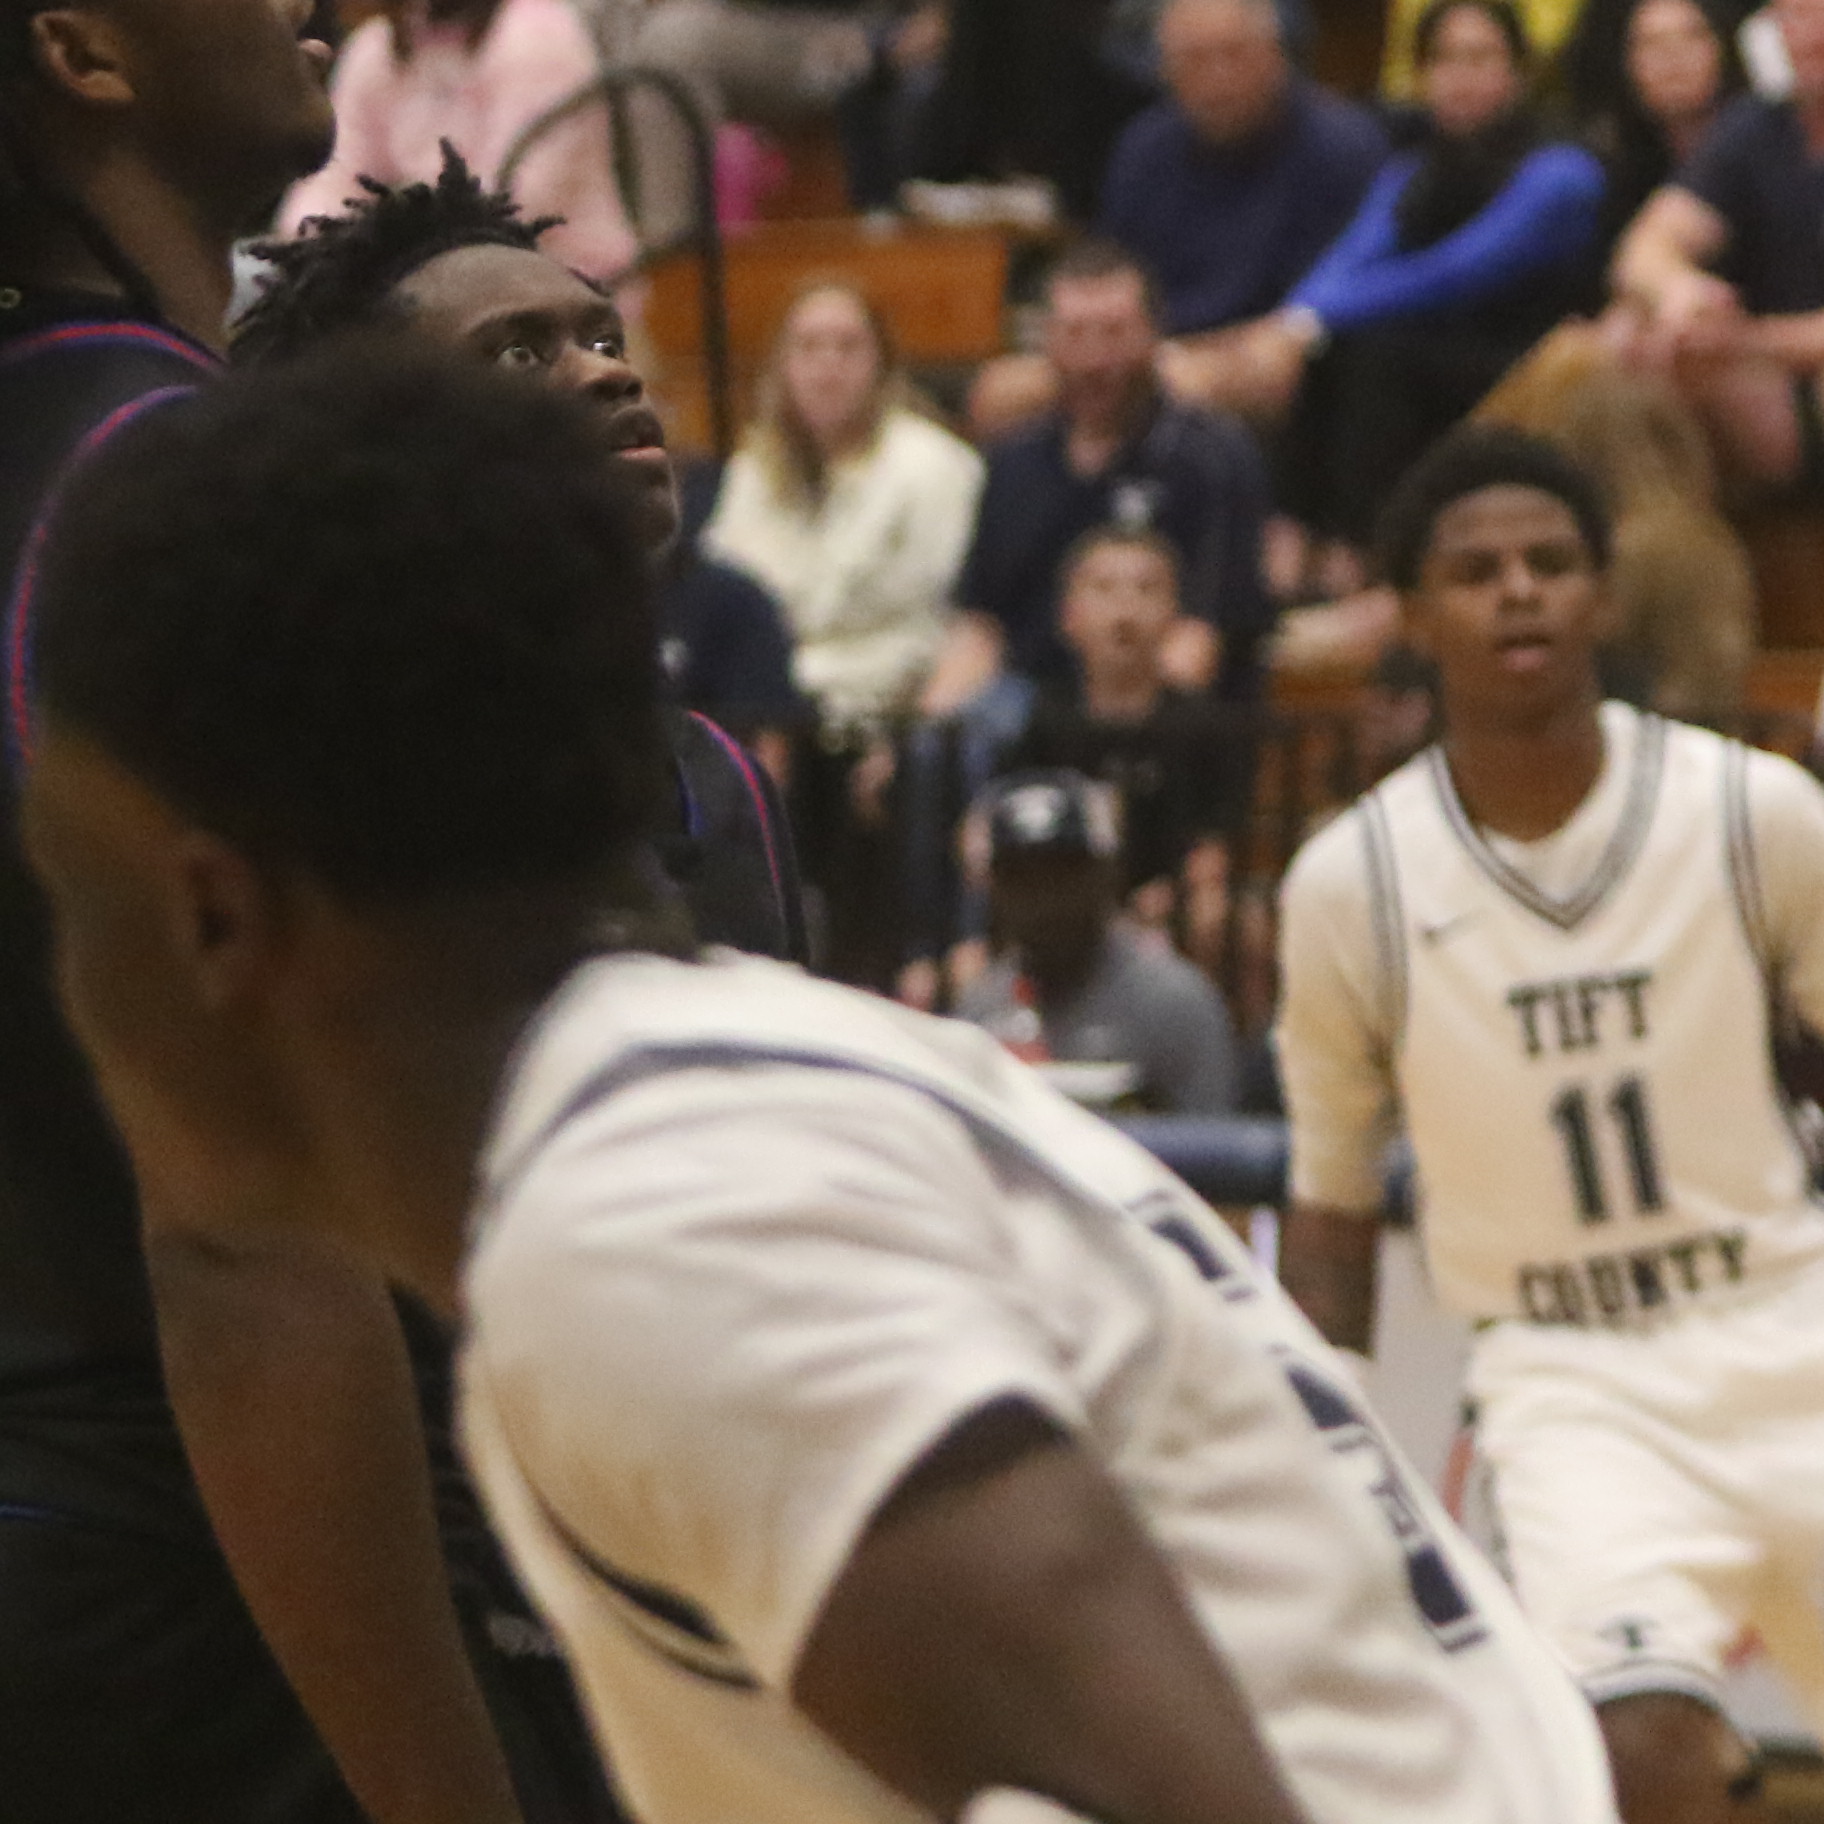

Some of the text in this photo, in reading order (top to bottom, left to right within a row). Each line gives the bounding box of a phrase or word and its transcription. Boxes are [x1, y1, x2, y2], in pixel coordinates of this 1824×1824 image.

[1508, 972, 1652, 1058] TIFT
[1551, 1076, 1661, 1225] 11
[1518, 1231, 1748, 1324] COUNTY
